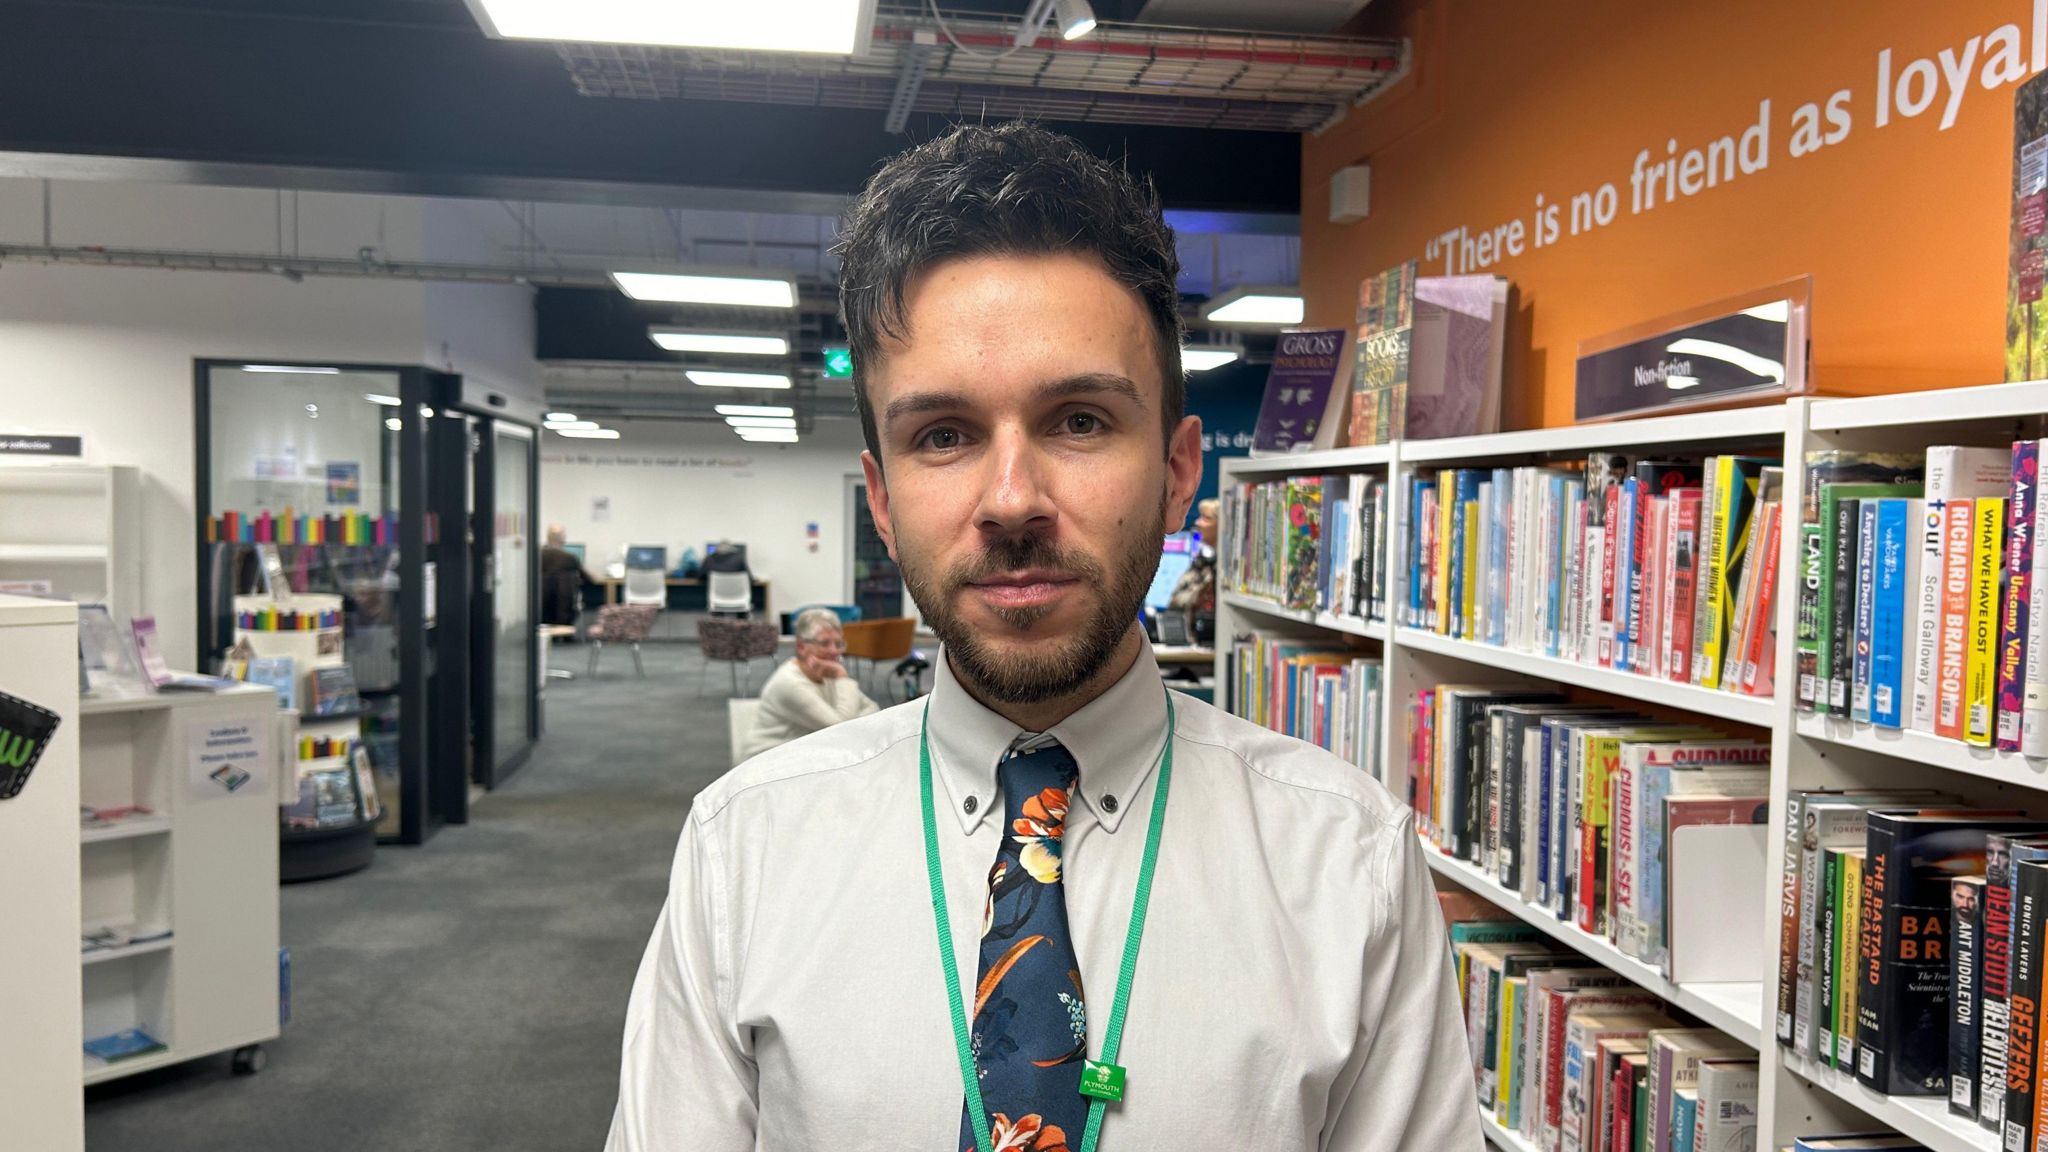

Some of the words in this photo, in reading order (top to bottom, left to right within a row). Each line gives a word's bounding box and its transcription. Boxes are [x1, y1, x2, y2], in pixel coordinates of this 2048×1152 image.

[1534, 193, 1560, 248] is
[1570, 182, 1617, 236] no
[1630, 99, 1772, 214] friend
[1789, 88, 1852, 157] as
[1875, 0, 2048, 131] loyal
[1283, 334, 1337, 356] GROSS
[1366, 333, 1400, 359] BOOKS
[1633, 357, 1692, 387] Non-fiction
[1932, 467, 1943, 490] the
[2014, 480, 2029, 518] Anna
[1606, 500, 1618, 535] Sara
[1983, 508, 1994, 552] WHAT
[1837, 539, 1848, 571] PLACE
[1861, 511, 1874, 567] Anything
[1947, 506, 1969, 593] RICHARD
[2011, 522, 2028, 572] Wiener
[1603, 537, 1616, 589] Pascoe
[1806, 534, 1821, 590] LAND
[1861, 568, 1871, 582] to
[1981, 554, 1993, 577] WE
[1859, 582, 1871, 636] Declare?
[1923, 575, 1937, 613] Scott
[1978, 579, 1991, 617] HAVE
[2005, 575, 2024, 634] Uncanny
[2031, 588, 2044, 627] Satya
[1628, 592, 1641, 640] BRAND
[1917, 619, 1935, 686] Galloway
[1941, 613, 1964, 700] BRANSON
[1976, 620, 1988, 655] LOST
[2027, 634, 2040, 683] Nadell
[2002, 638, 2021, 681] Valley
[1618, 767, 1632, 853] CURIOUS
[1787, 800, 1800, 842] DAN
[1616, 866, 1632, 908] SEX
[1782, 846, 1797, 918] JARVIS
[1804, 855, 1816, 913] WOMEN
[1846, 872, 1854, 908] GOING
[1875, 853, 1885, 892] THE
[1861, 874, 1874, 958] BRIGADE
[1985, 884, 2011, 937] DEAN
[2020, 895, 2033, 937] MONICA
[1802, 927, 1813, 960] WAR
[1823, 910, 1834, 976] Christopher
[1869, 894, 1884, 986] BASTARD
[1957, 920, 1973, 948] ANT
[1917, 971, 1933, 980] The
[1983, 937, 2010, 997] STOTT
[2018, 941, 2030, 982] LAVERS
[1821, 976, 1831, 1007] Wylie
[1957, 950, 1973, 1026] MIDDLETON
[2006, 993, 2035, 1095] GEEZERS
[1084, 1079, 1120, 1093] PLYMOUTH
[1676, 1104, 1685, 1142] HOW
